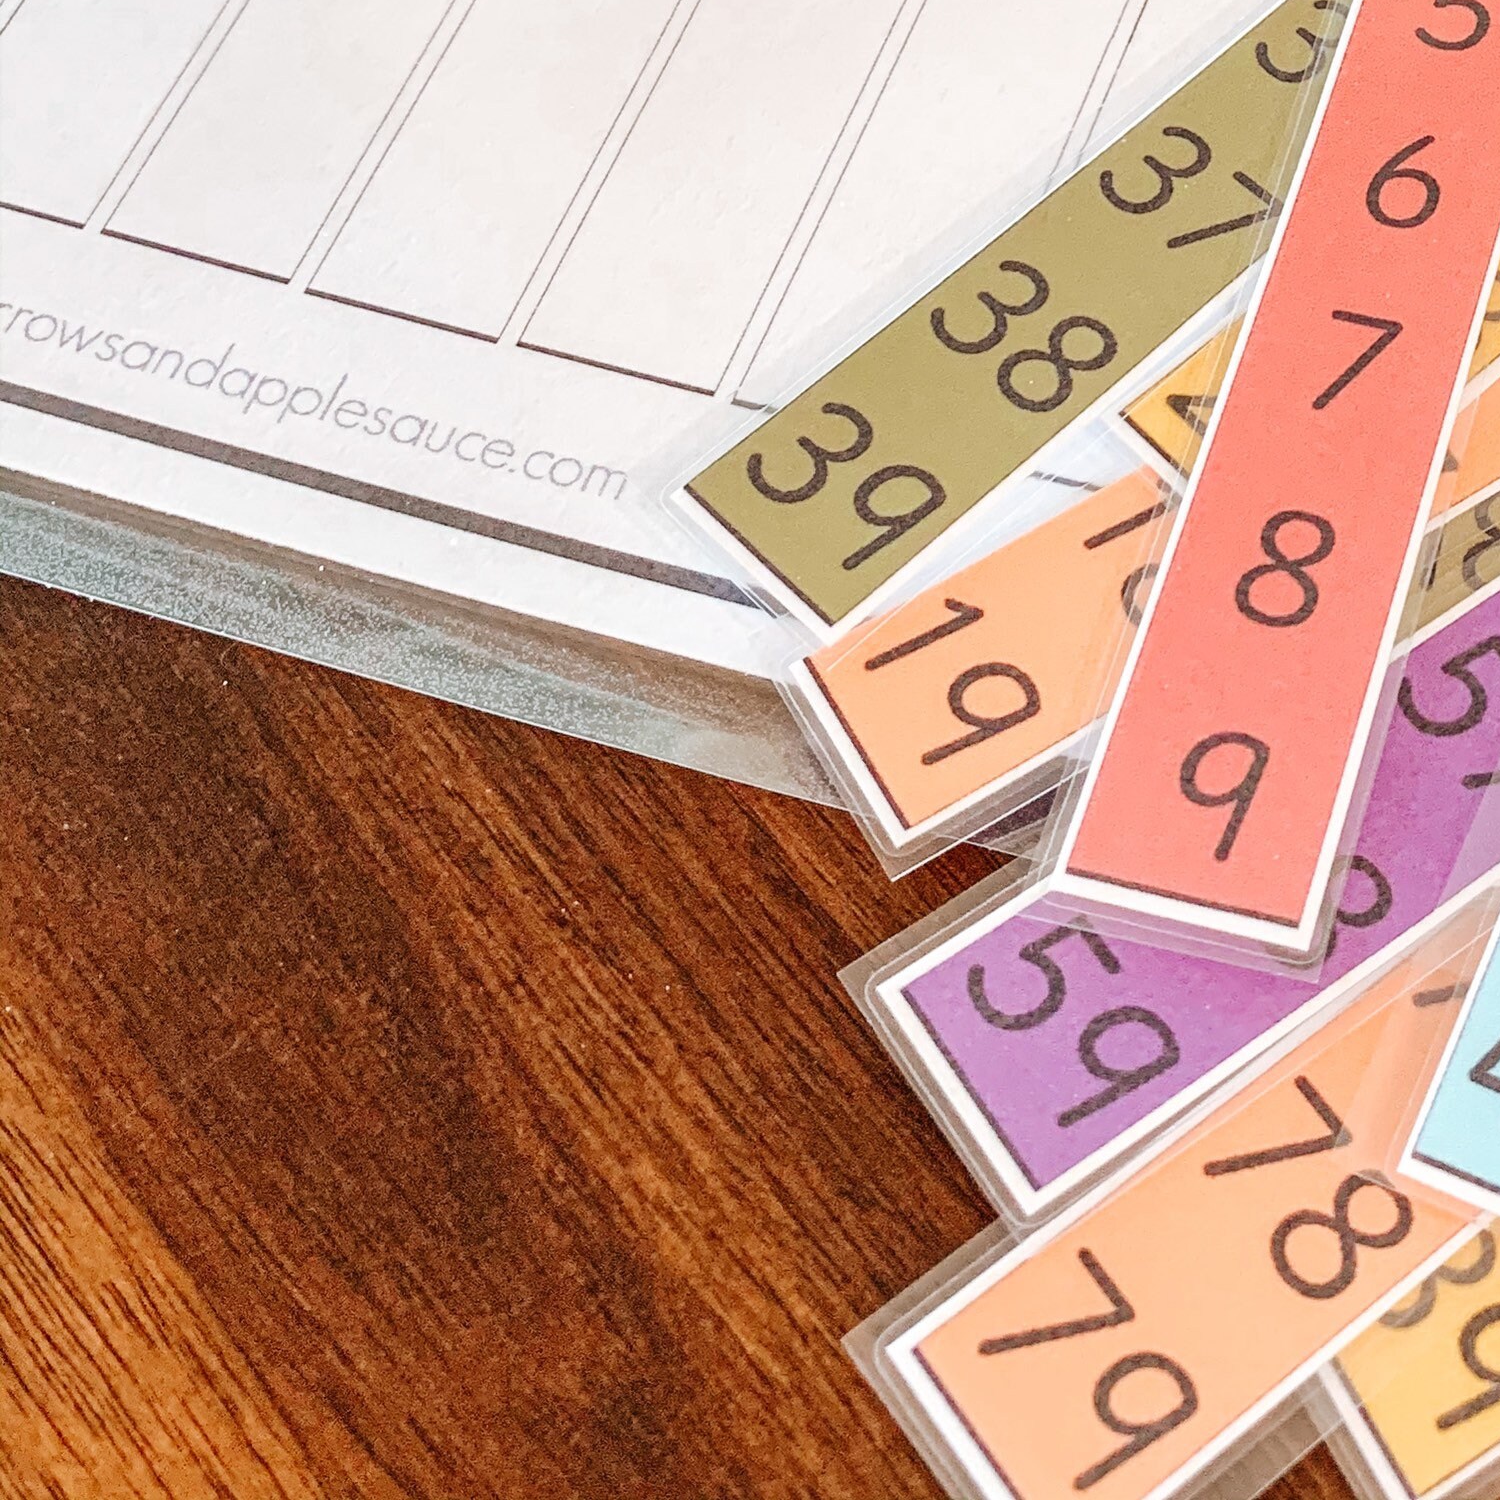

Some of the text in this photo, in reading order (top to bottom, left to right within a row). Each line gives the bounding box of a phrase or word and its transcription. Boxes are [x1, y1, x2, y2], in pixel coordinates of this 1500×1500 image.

[1255, 0, 1350, 83] 3
[1099, 126, 1284, 249] 37
[1365, 135, 1441, 229] 6
[929, 260, 1118, 413] 38
[1311, 310, 1404, 410] 7
[746, 402, 947, 571] 39
[1234, 509, 1337, 628] 8
[865, 598, 1042, 767] 19
[1178, 731, 1271, 861] 9
[966, 913, 1181, 1129] 59
[1202, 1074, 1414, 1300] 78
[978, 1246, 1199, 1492] 79
